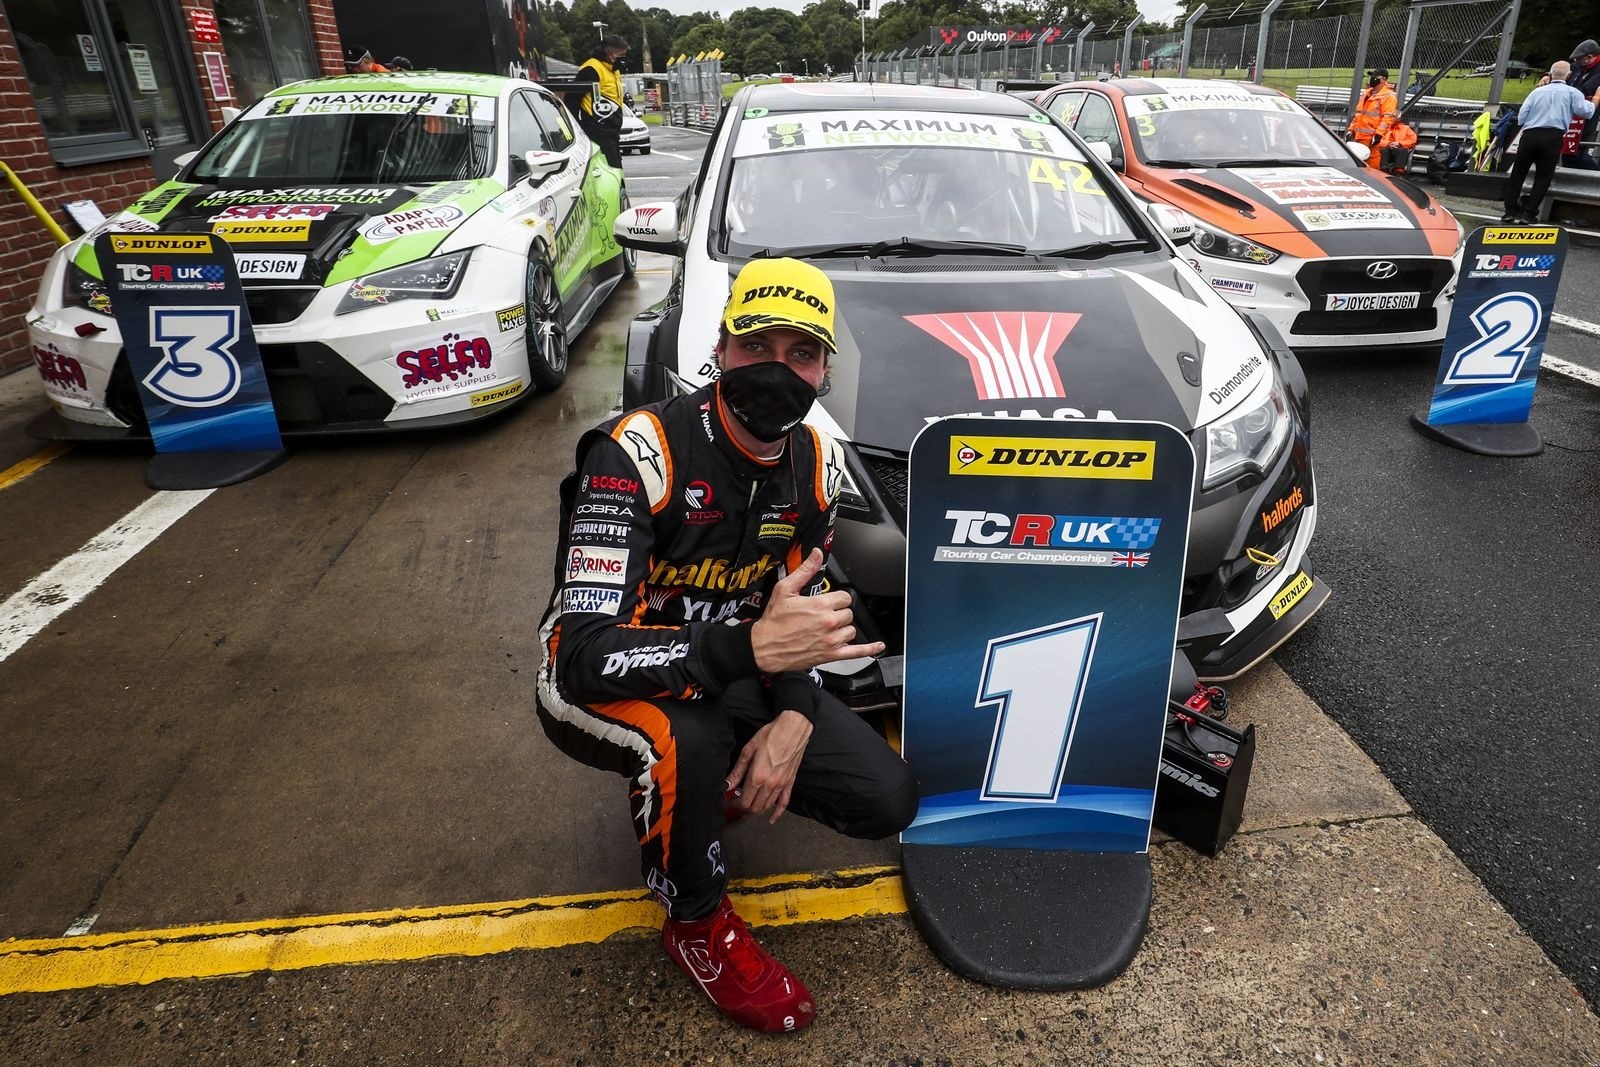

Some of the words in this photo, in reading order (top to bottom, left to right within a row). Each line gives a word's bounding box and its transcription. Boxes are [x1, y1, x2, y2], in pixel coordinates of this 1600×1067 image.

[308, 94, 439, 105] MAXIMUM
[1171, 93, 1265, 104] MAXIMUM
[821, 119, 997, 136] MAXIMUM
[824, 130, 1001, 146] NETWORKS
[1028, 157, 1108, 196] 42
[206, 188, 398, 199] MAXIMUM
[195, 196, 389, 208] NETWORKS.CO.UK
[384, 208, 434, 225] ADAPT
[229, 225, 308, 235] DUNLOP
[394, 217, 449, 234] PAPER
[627, 227, 658, 235] YUASA
[1497, 232, 1555, 240] DUNLOP
[131, 240, 207, 249] DUNLOP
[239, 259, 298, 273] DESIGN
[1475, 254, 1517, 270] TCR
[1517, 257, 1540, 267] UK
[116, 263, 173, 281] TCR
[176, 267, 204, 279] UK
[1211, 278, 1244, 290] CHAMPION
[1244, 282, 1254, 291] RV
[355, 289, 386, 297] SUNOCO
[742, 285, 829, 315] DUNLOP
[1344, 296, 1377, 310] JOYCE
[1379, 295, 1416, 309] DESIGN
[499, 307, 525, 322] POWER
[501, 317, 526, 332] MAXED
[1443, 291, 1542, 385] 2
[142, 306, 241, 407] 3
[396, 336, 492, 388] SELCO
[406, 385, 451, 399] HYGIENE
[454, 373, 497, 389] SUPPLIES
[1208, 354, 1262, 406] Diamondbrite
[482, 384, 523, 402] DUNLOP
[701, 411, 714, 442] YUASA
[987, 448, 1148, 468] DUNLOP
[592, 475, 639, 494] BOSCH
[614, 493, 624, 502] for
[625, 495, 635, 504] life
[576, 504, 634, 517] COBRA
[1262, 486, 1303, 533] halfords
[944, 509, 1055, 547] TCR
[1061, 521, 1116, 544] UK
[942, 549, 987, 562] Touring
[990, 550, 1014, 561] Car
[1016, 551, 1107, 565] Championship
[564, 589, 620, 603] ARTHUR
[1280, 577, 1308, 609] DUNLOP
[563, 601, 604, 612] McKAY
[974, 612, 1104, 803] 1
